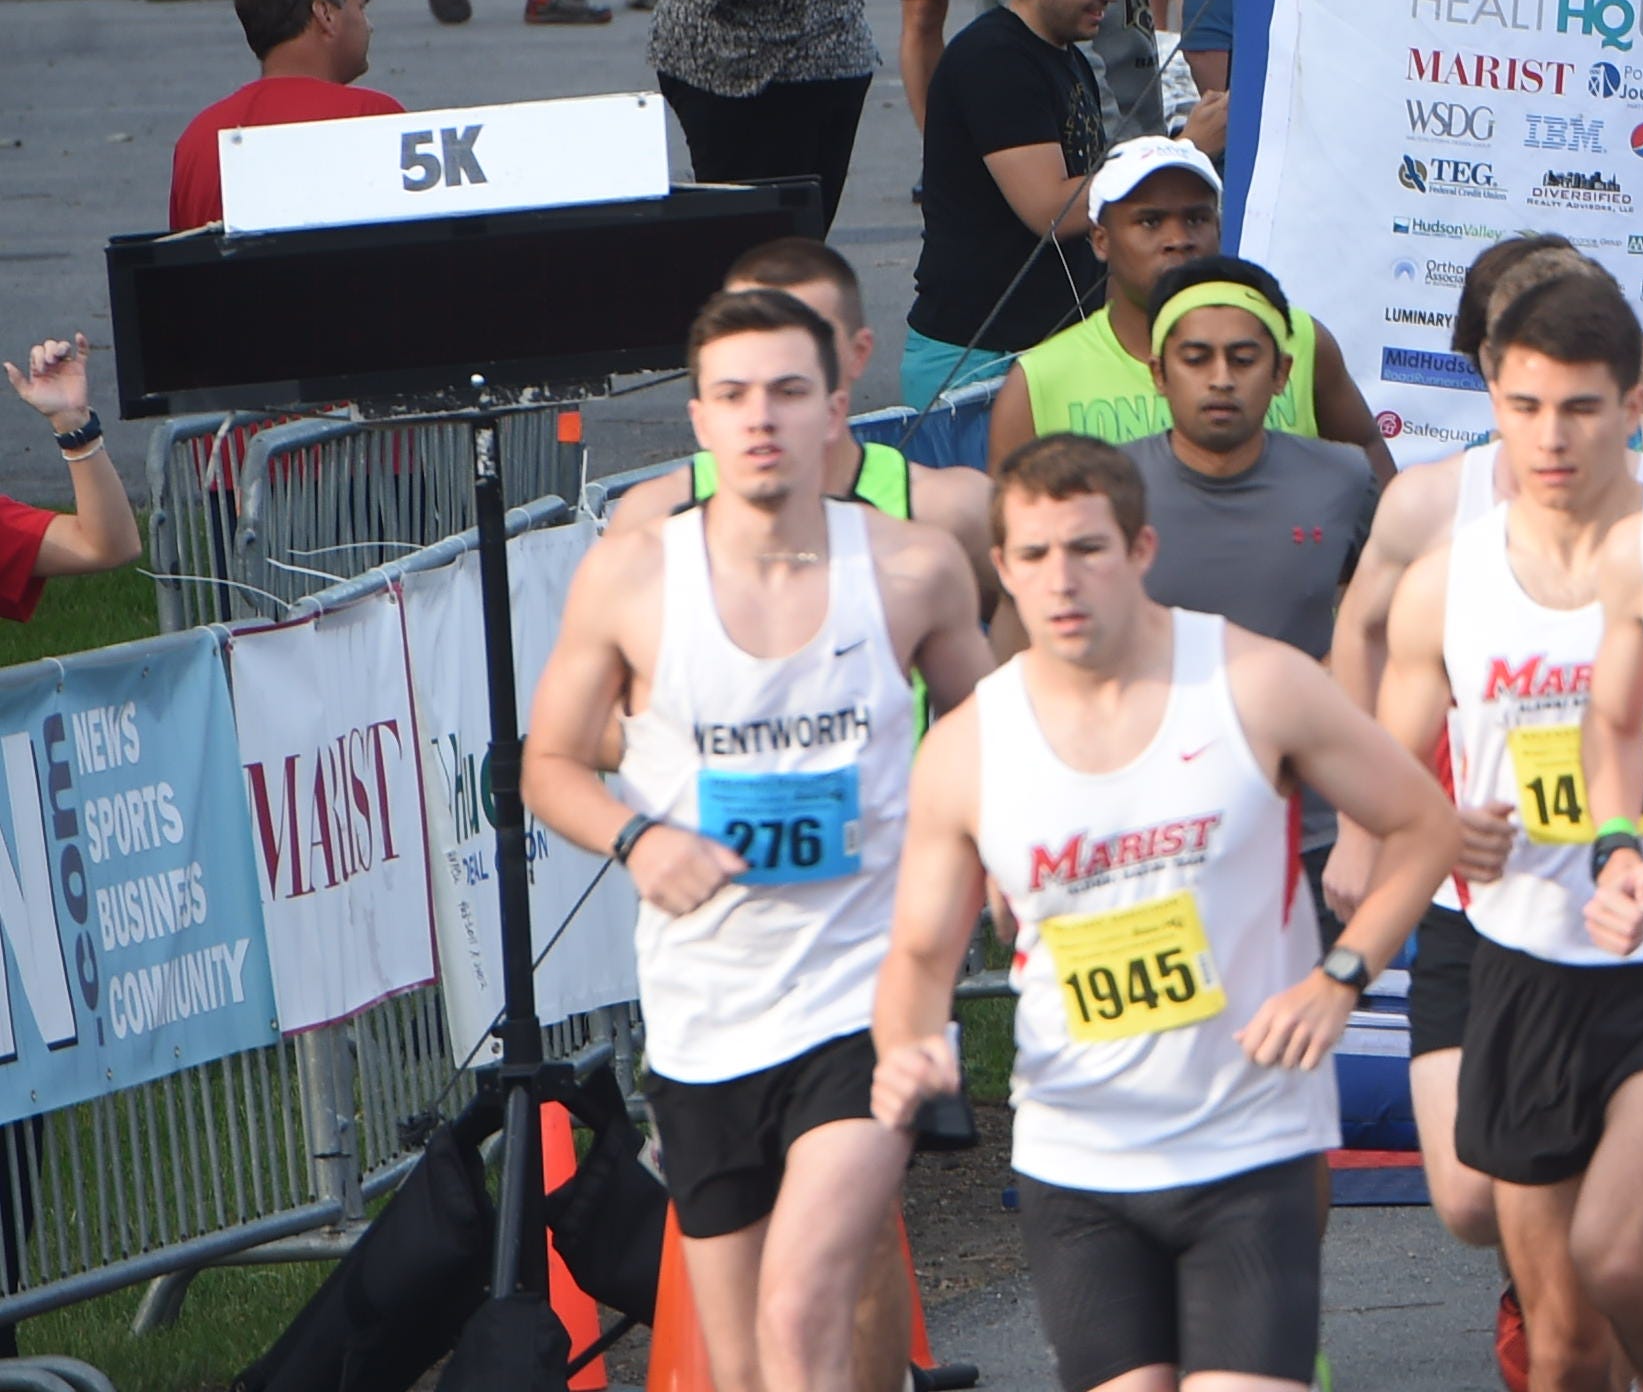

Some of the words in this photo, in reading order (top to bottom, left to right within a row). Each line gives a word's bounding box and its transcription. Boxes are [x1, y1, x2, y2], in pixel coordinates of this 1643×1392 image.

[1404, 47, 1576, 96] MARIST
[1405, 99, 1496, 142] WSDG
[1523, 114, 1605, 154] IBM
[400, 123, 488, 192] 5K
[1532, 187, 1632, 205] DIVERSIFIED
[1412, 218, 1501, 241] HudsonValley
[1385, 307, 1453, 329] LUMINARY
[1482, 653, 1596, 704] MAR
[71, 700, 141, 776] NEWS
[84, 782, 185, 864] SPORTS
[243, 720, 403, 906] MARIST
[725, 816, 822, 870] 276
[1027, 810, 1224, 894] MARIST
[1065, 947, 1197, 1024] 1945
